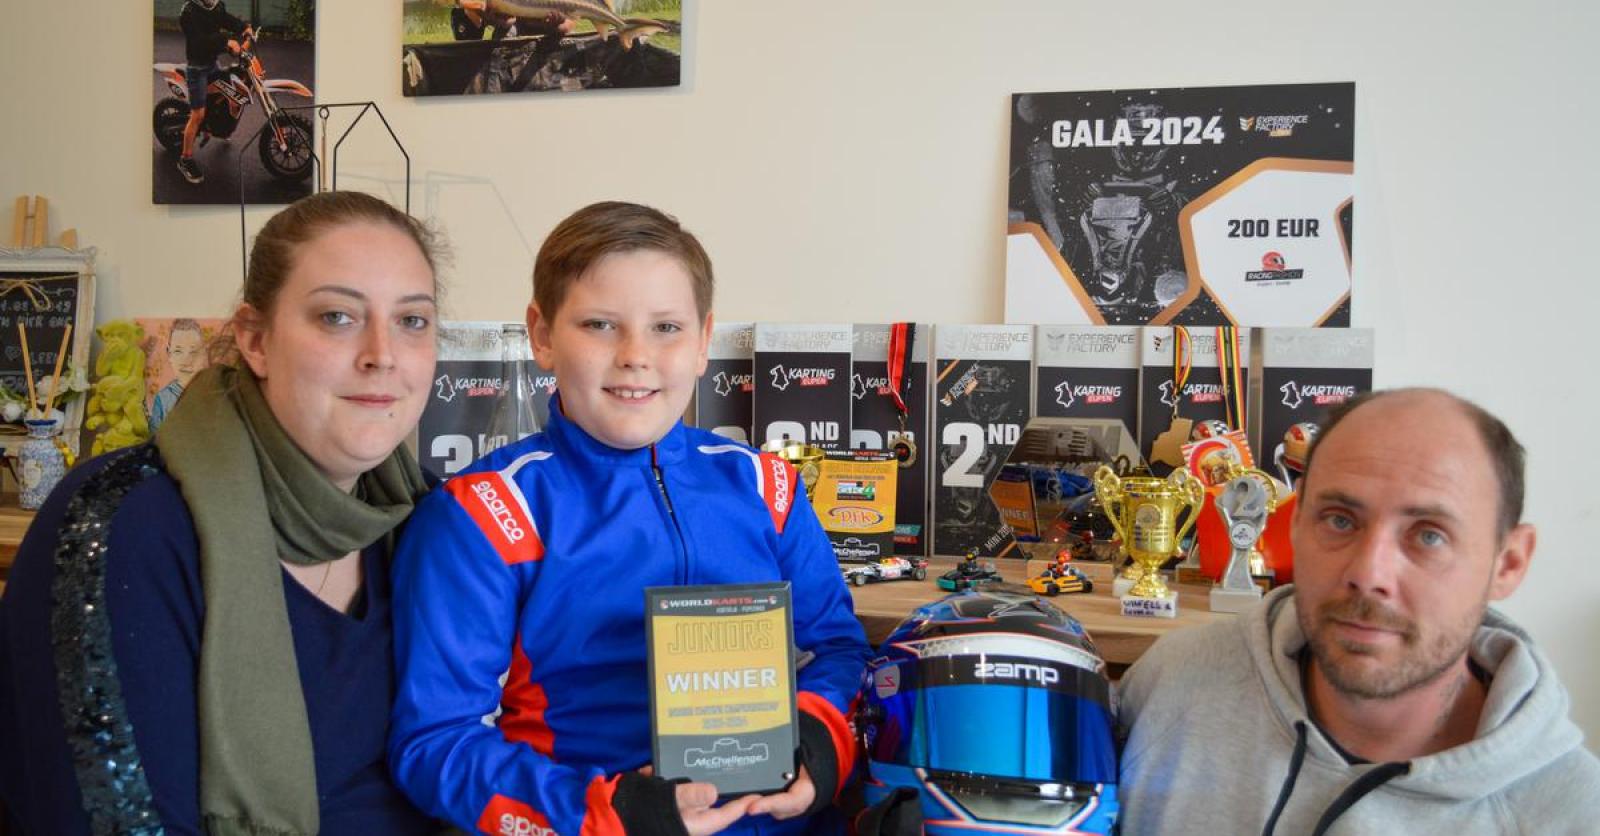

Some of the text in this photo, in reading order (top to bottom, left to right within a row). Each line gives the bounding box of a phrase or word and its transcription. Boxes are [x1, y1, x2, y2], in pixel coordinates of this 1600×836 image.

[1052, 115, 1225, 148] GALA 2024
[1228, 218, 1320, 239] 200 EUR
[1066, 343, 1117, 353] FACTORY
[1068, 333, 1135, 344] EXPERIENCE
[788, 368, 836, 380] KARTING
[1073, 385, 1122, 397] KARTING
[1301, 385, 1355, 397] KARTING
[942, 422, 1021, 488] 2ND
[471, 481, 524, 544] sparco
[667, 619, 774, 655] JUNIORS
[666, 668, 777, 693] WINNER
[974, 662, 1059, 685] zamp
